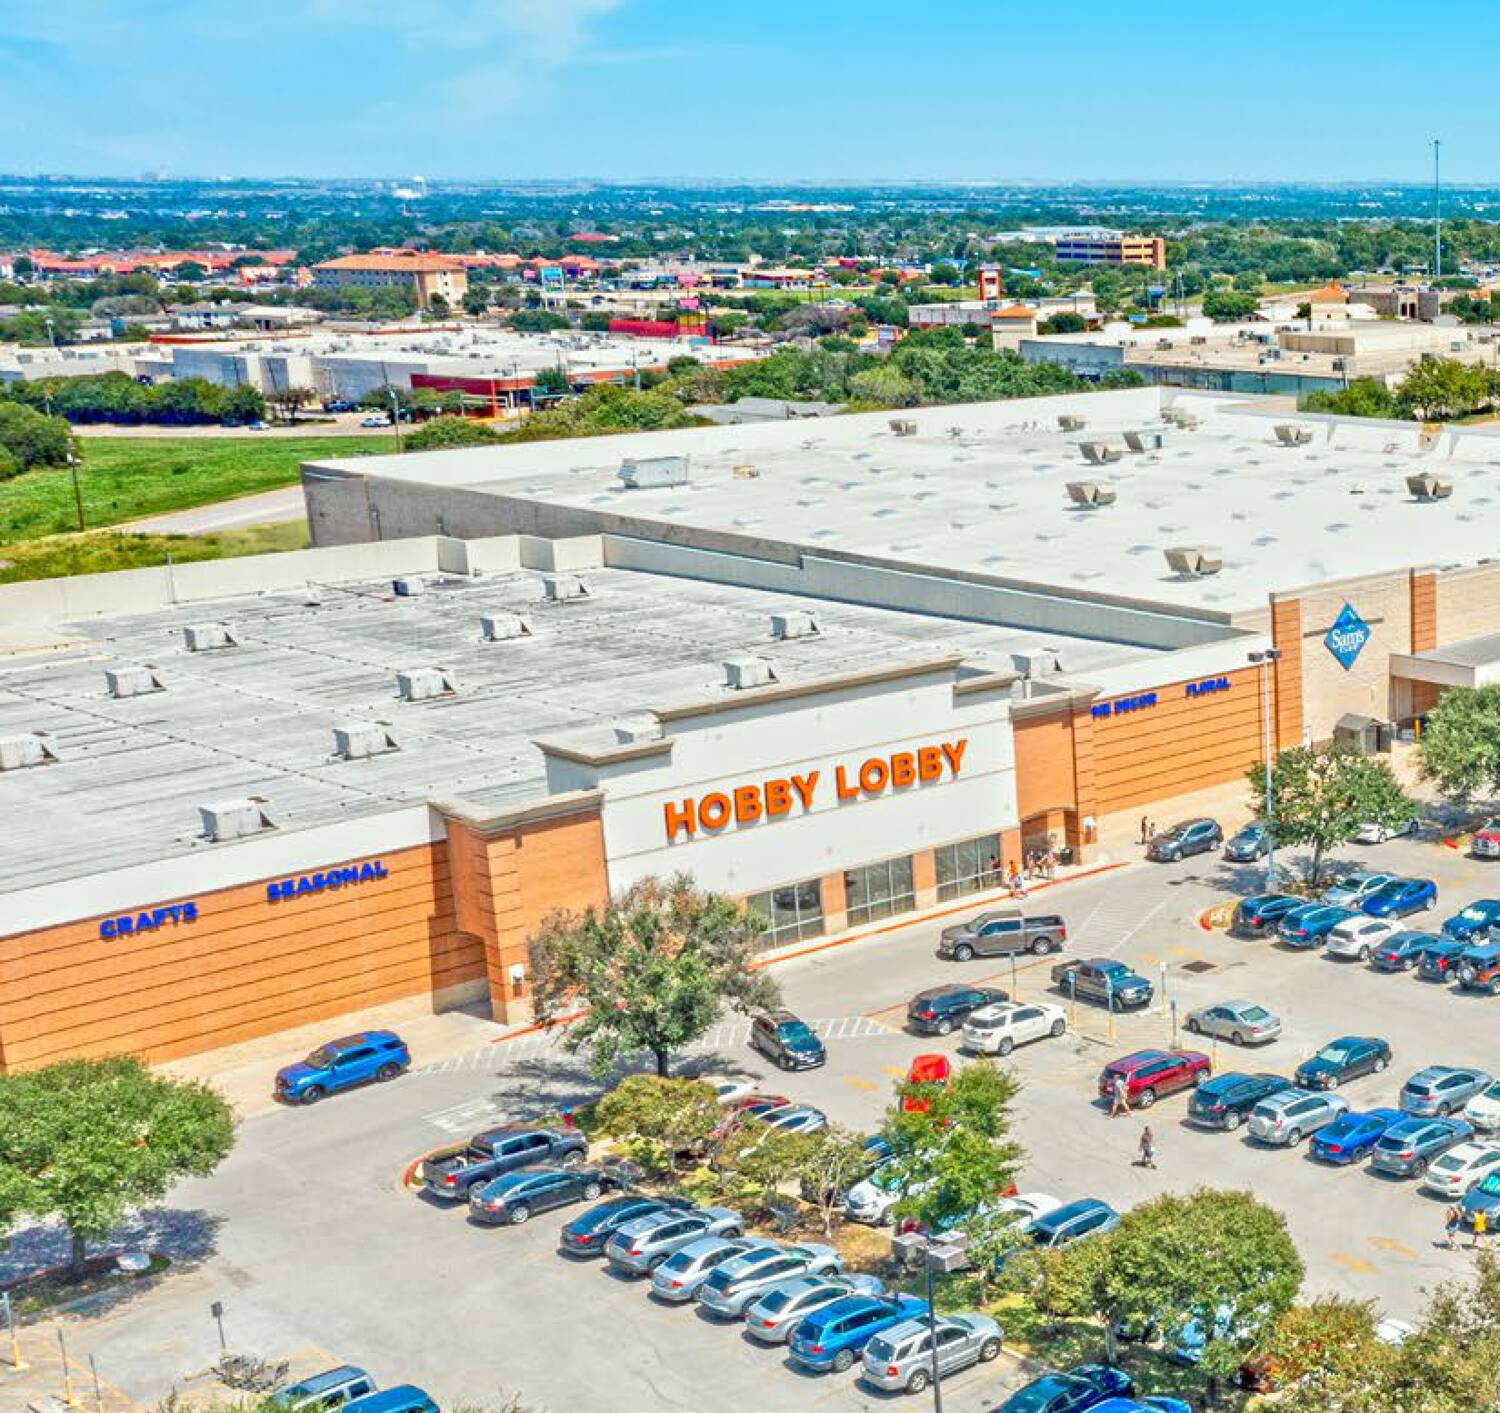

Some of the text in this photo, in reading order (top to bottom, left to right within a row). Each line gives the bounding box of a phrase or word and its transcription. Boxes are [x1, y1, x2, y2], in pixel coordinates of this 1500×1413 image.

[1186, 677, 1231, 697] FLORAL
[664, 739, 967, 840] HOBBY LOBBY
[267, 860, 388, 901] SEASONAL
[100, 902, 198, 938] CRAFTS
